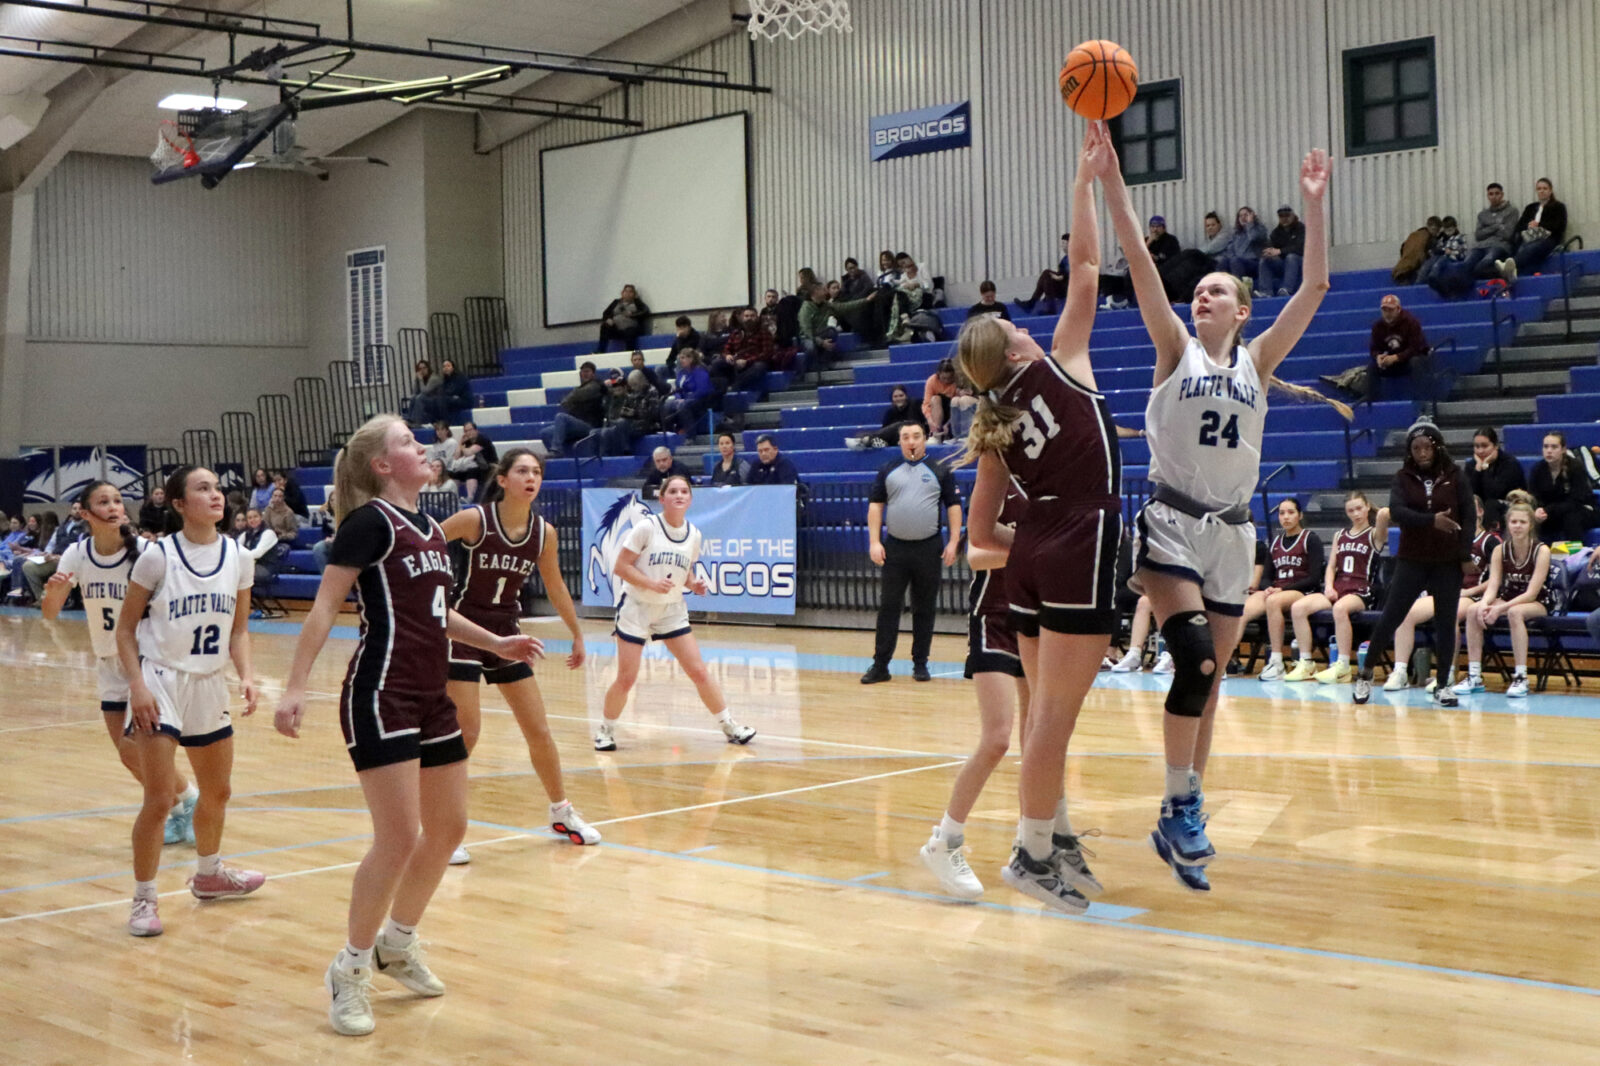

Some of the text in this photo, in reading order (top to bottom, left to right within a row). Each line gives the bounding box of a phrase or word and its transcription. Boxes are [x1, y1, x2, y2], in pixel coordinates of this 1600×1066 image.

[874, 115, 966, 146] BRONCOS
[1179, 374, 1223, 401] PLATTE
[1011, 393, 1061, 459] 31
[1198, 409, 1240, 449] 24
[648, 551, 674, 566] PLATTE
[700, 538, 794, 558] ME OF THE
[402, 550, 454, 578] EAGLE
[1343, 555, 1355, 573] 0
[83, 582, 105, 599] LATTE
[492, 576, 507, 604] 1
[684, 561, 795, 598] NCOS
[102, 607, 115, 631] 5
[168, 593, 207, 621] PLATTE
[431, 585, 447, 628] 4
[190, 624, 220, 655] 12
